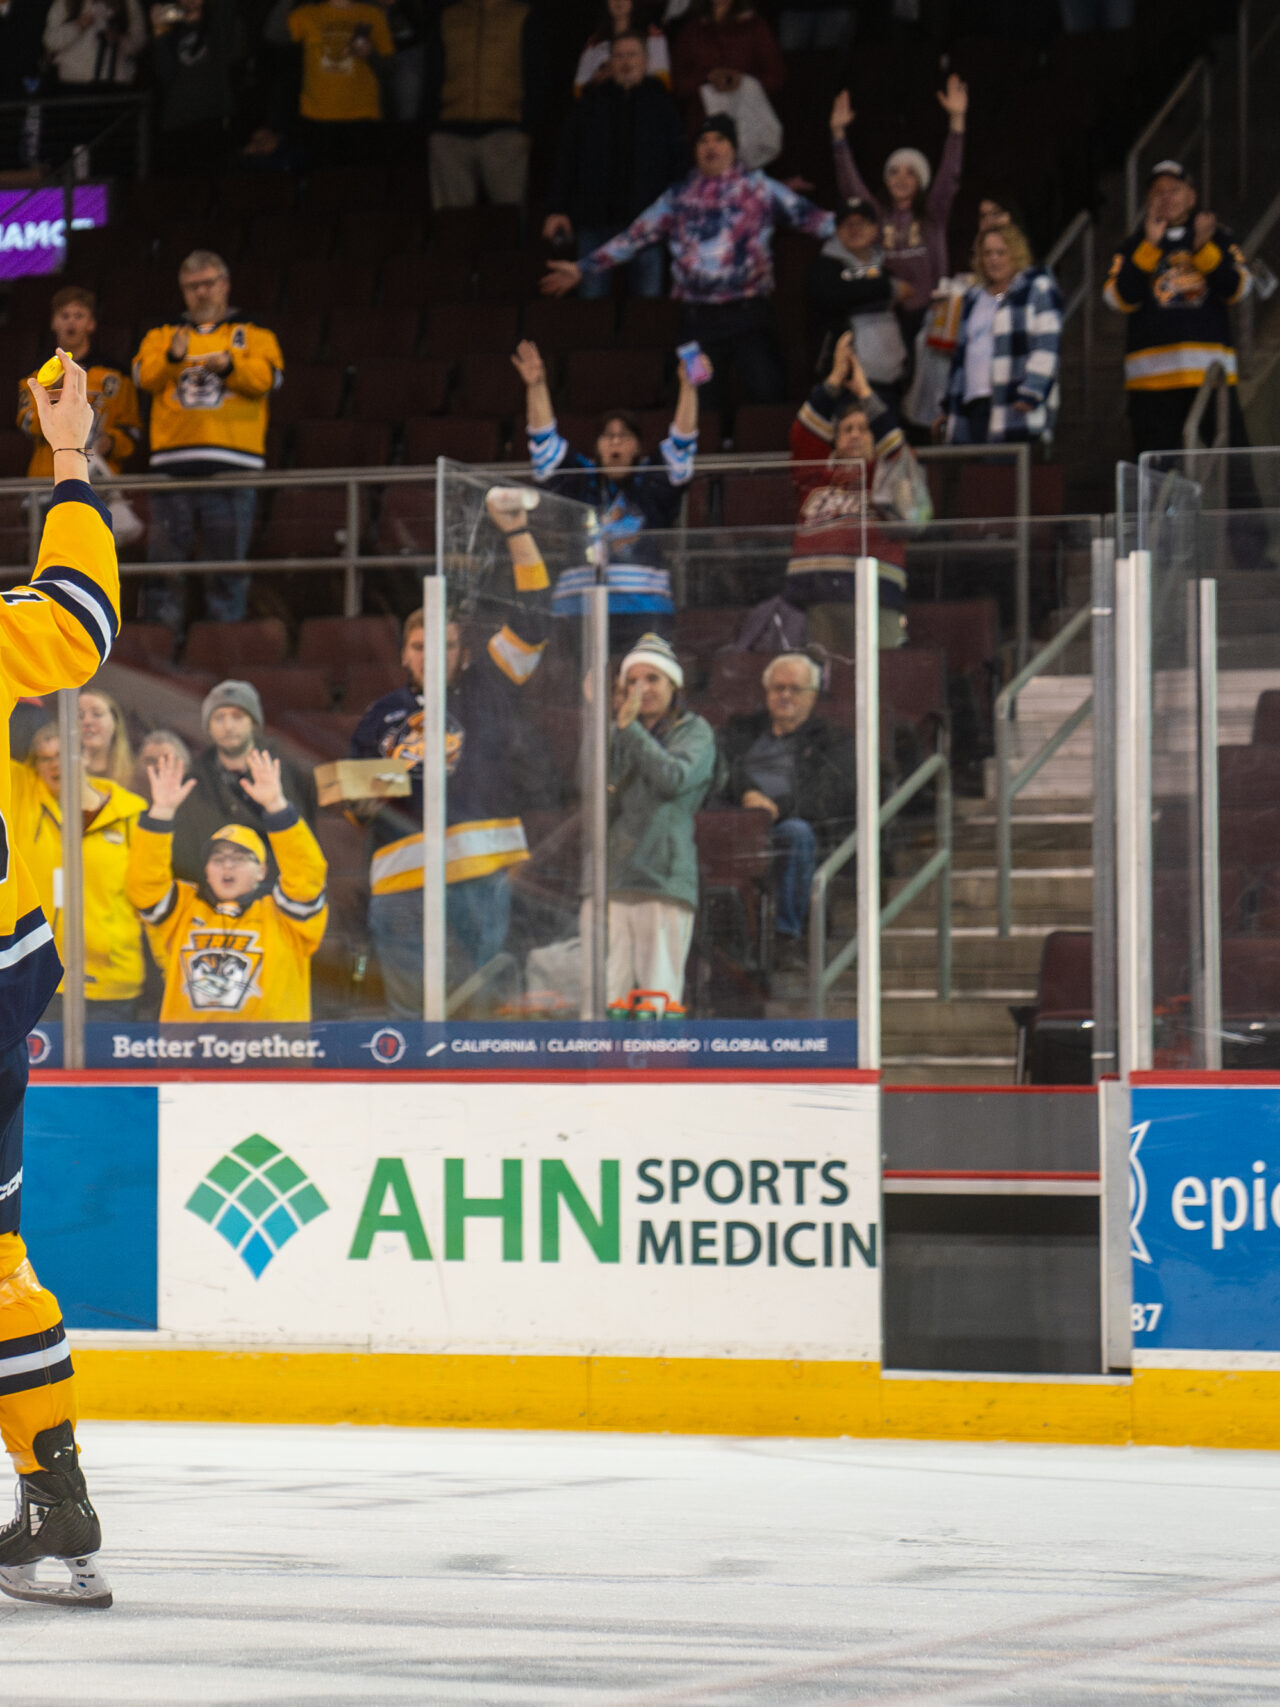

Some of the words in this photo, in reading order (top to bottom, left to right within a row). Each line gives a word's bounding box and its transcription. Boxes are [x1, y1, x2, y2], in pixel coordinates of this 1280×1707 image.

[112, 1035, 195, 1058] Better
[198, 1035, 326, 1064] Together.
[451, 1038, 538, 1053] CALIFORNIA
[547, 1038, 612, 1053] CLARION
[623, 1038, 701, 1053] EDINBORO
[711, 1038, 768, 1053] GLOBAL
[772, 1038, 828, 1053] ONLINE
[636, 1158, 849, 1206] SPORTS
[346, 1157, 620, 1263] AHN
[636, 1219, 879, 1268] MEDICIN
